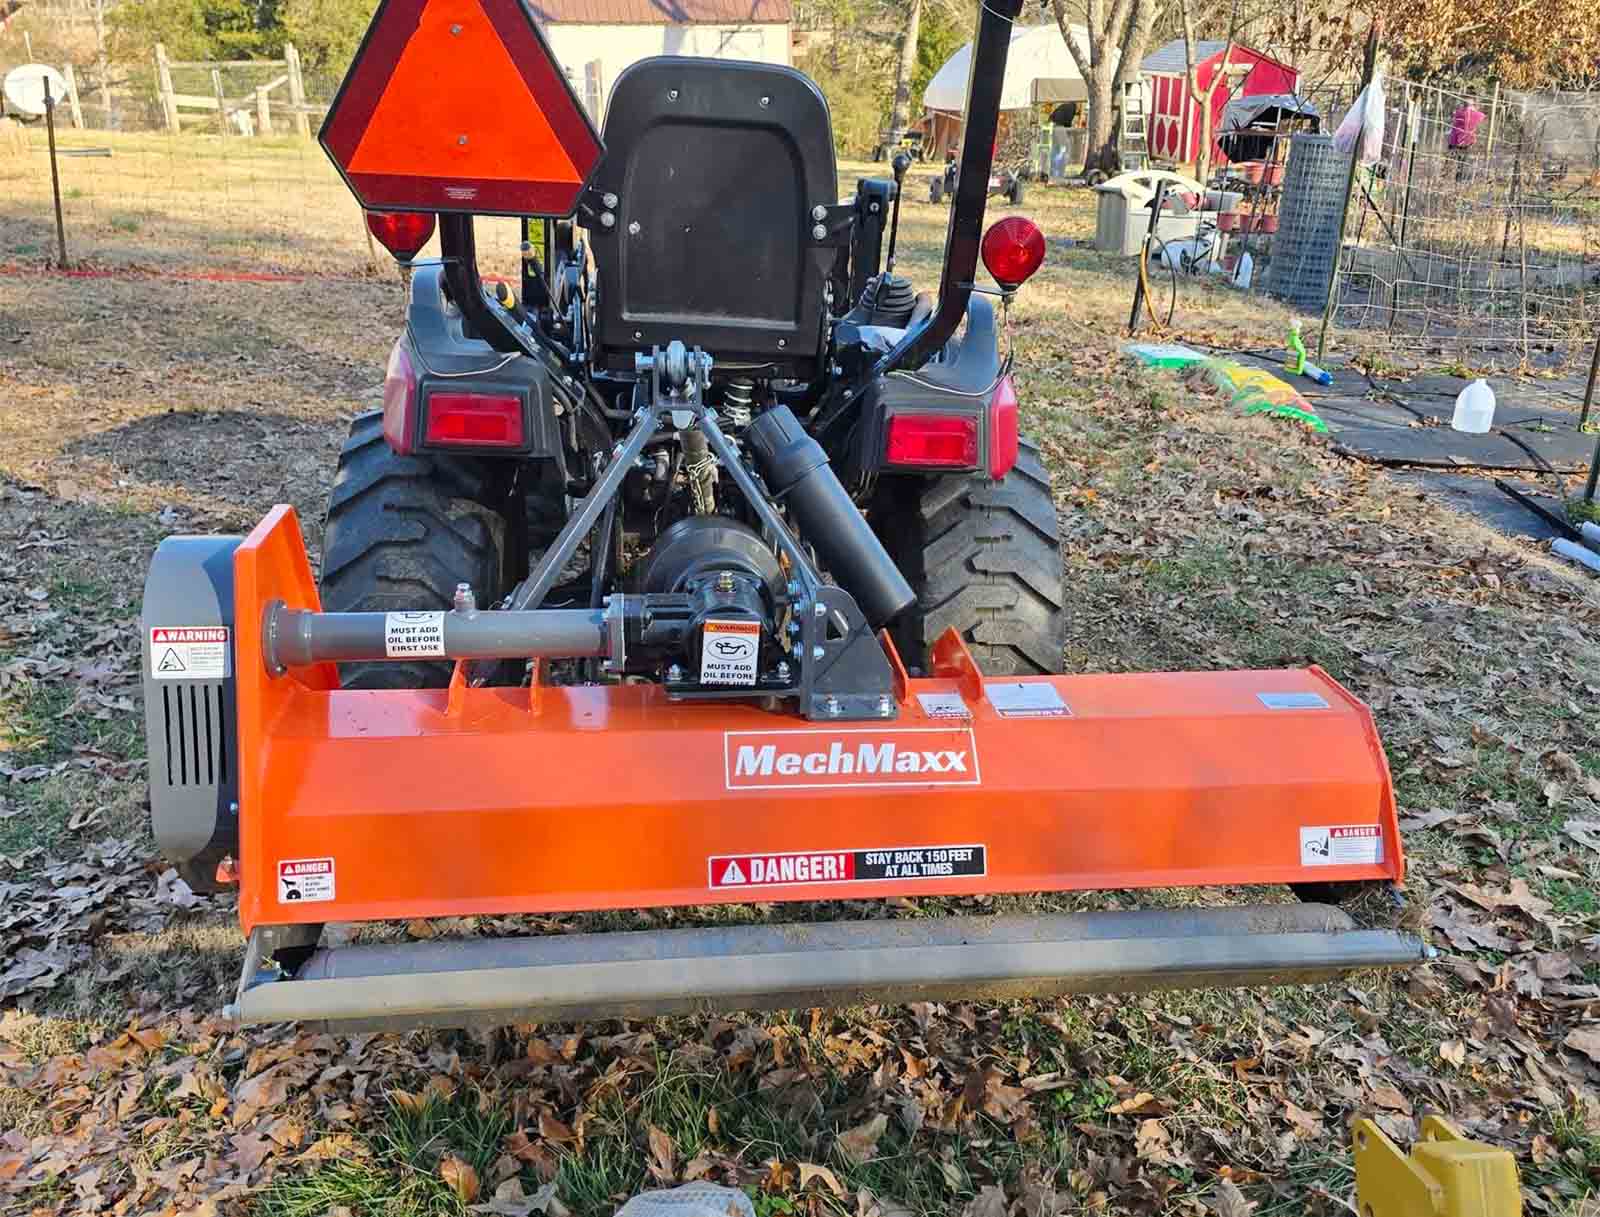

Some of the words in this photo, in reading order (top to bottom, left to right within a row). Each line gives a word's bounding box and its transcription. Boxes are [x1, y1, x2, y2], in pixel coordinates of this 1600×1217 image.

[168, 630, 226, 641] WARNING
[388, 636, 403, 644] OIL
[406, 635, 440, 643] BEFORE
[720, 672, 752, 680] BEFORE
[735, 742, 967, 776] MechMaxx
[1343, 828, 1376, 837] DANGER
[865, 851, 893, 865] STAY
[895, 851, 924, 863] BACK
[928, 850, 947, 862] 150
[948, 849, 973, 862] FEET
[295, 862, 329, 873] DANGER
[751, 854, 846, 882] DANGER!
[885, 865, 899, 878] AT
[901, 864, 919, 876] ALL
[922, 862, 953, 875] TIMES
